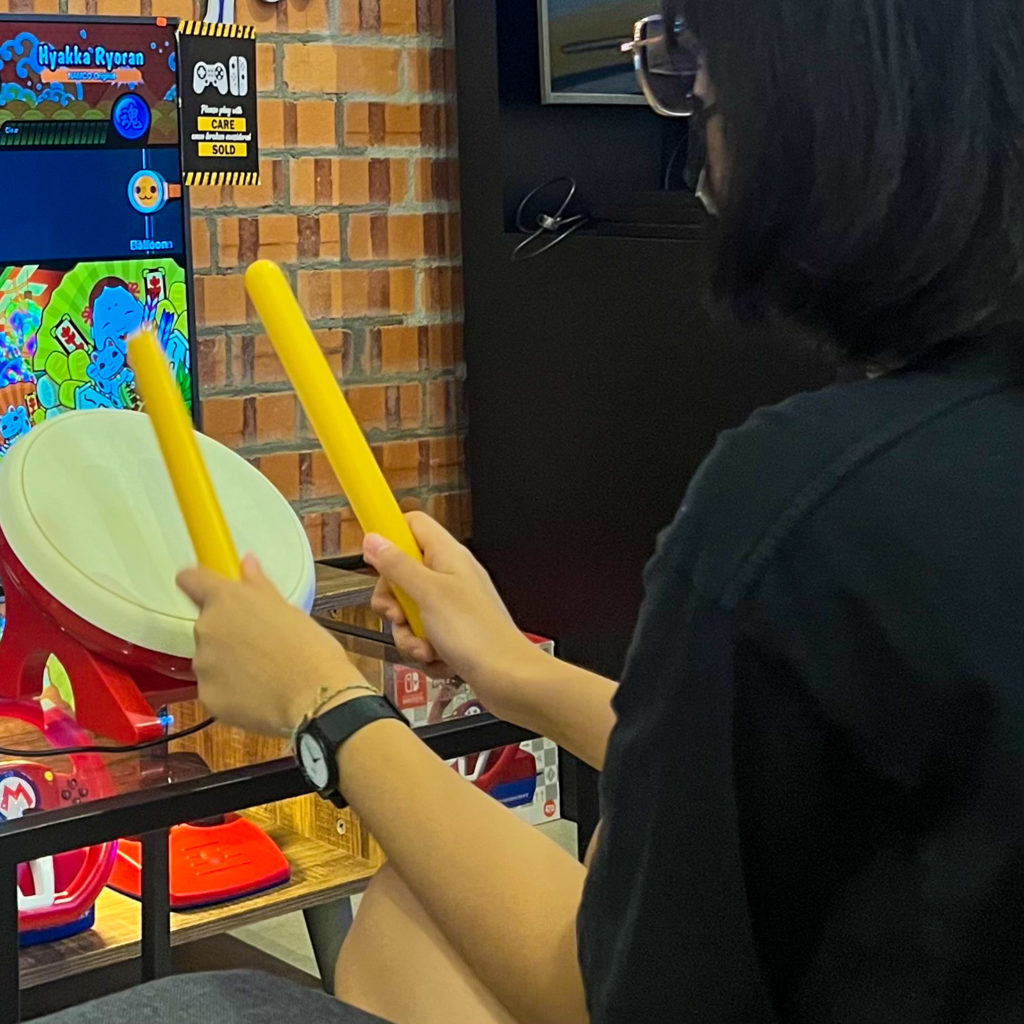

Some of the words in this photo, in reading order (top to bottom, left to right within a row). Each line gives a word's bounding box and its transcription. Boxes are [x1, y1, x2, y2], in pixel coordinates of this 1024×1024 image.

[38, 44, 91, 71] Hyakka
[95, 45, 145, 71] Ryoran
[118, 102, 143, 131] 魂
[211, 119, 235, 130] CARE
[212, 144, 236, 155] SOLD
